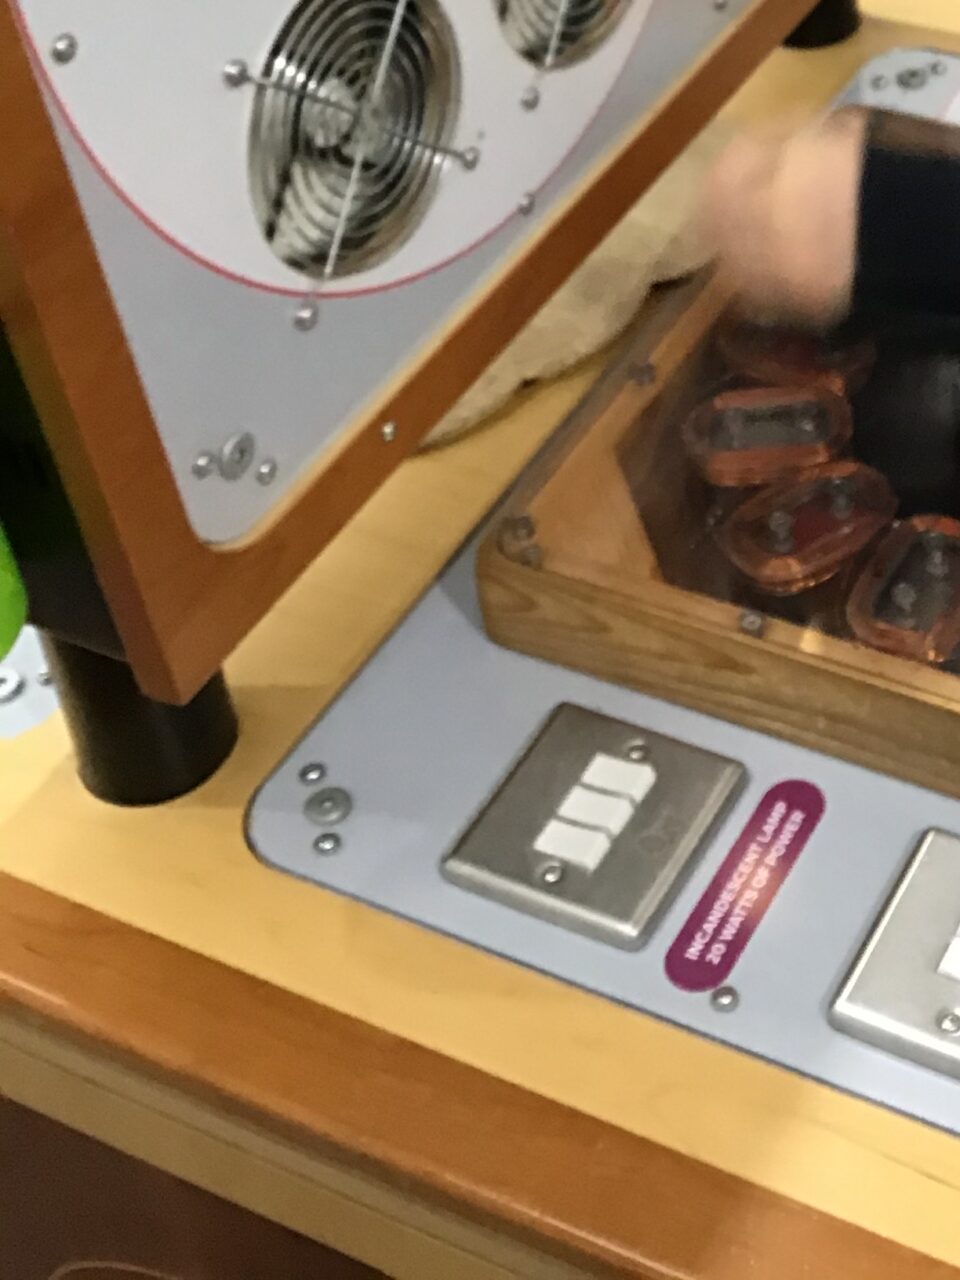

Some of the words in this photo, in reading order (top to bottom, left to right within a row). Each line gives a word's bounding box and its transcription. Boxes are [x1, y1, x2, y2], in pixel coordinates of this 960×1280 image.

[684, 842, 762, 961] INCANDESCENT
[756, 800, 787, 843] LAMP
[705, 942, 729, 966] 20
[719, 888, 760, 942] WATTS
[751, 866, 772, 889] OF
[763, 809, 807, 867] POWER
